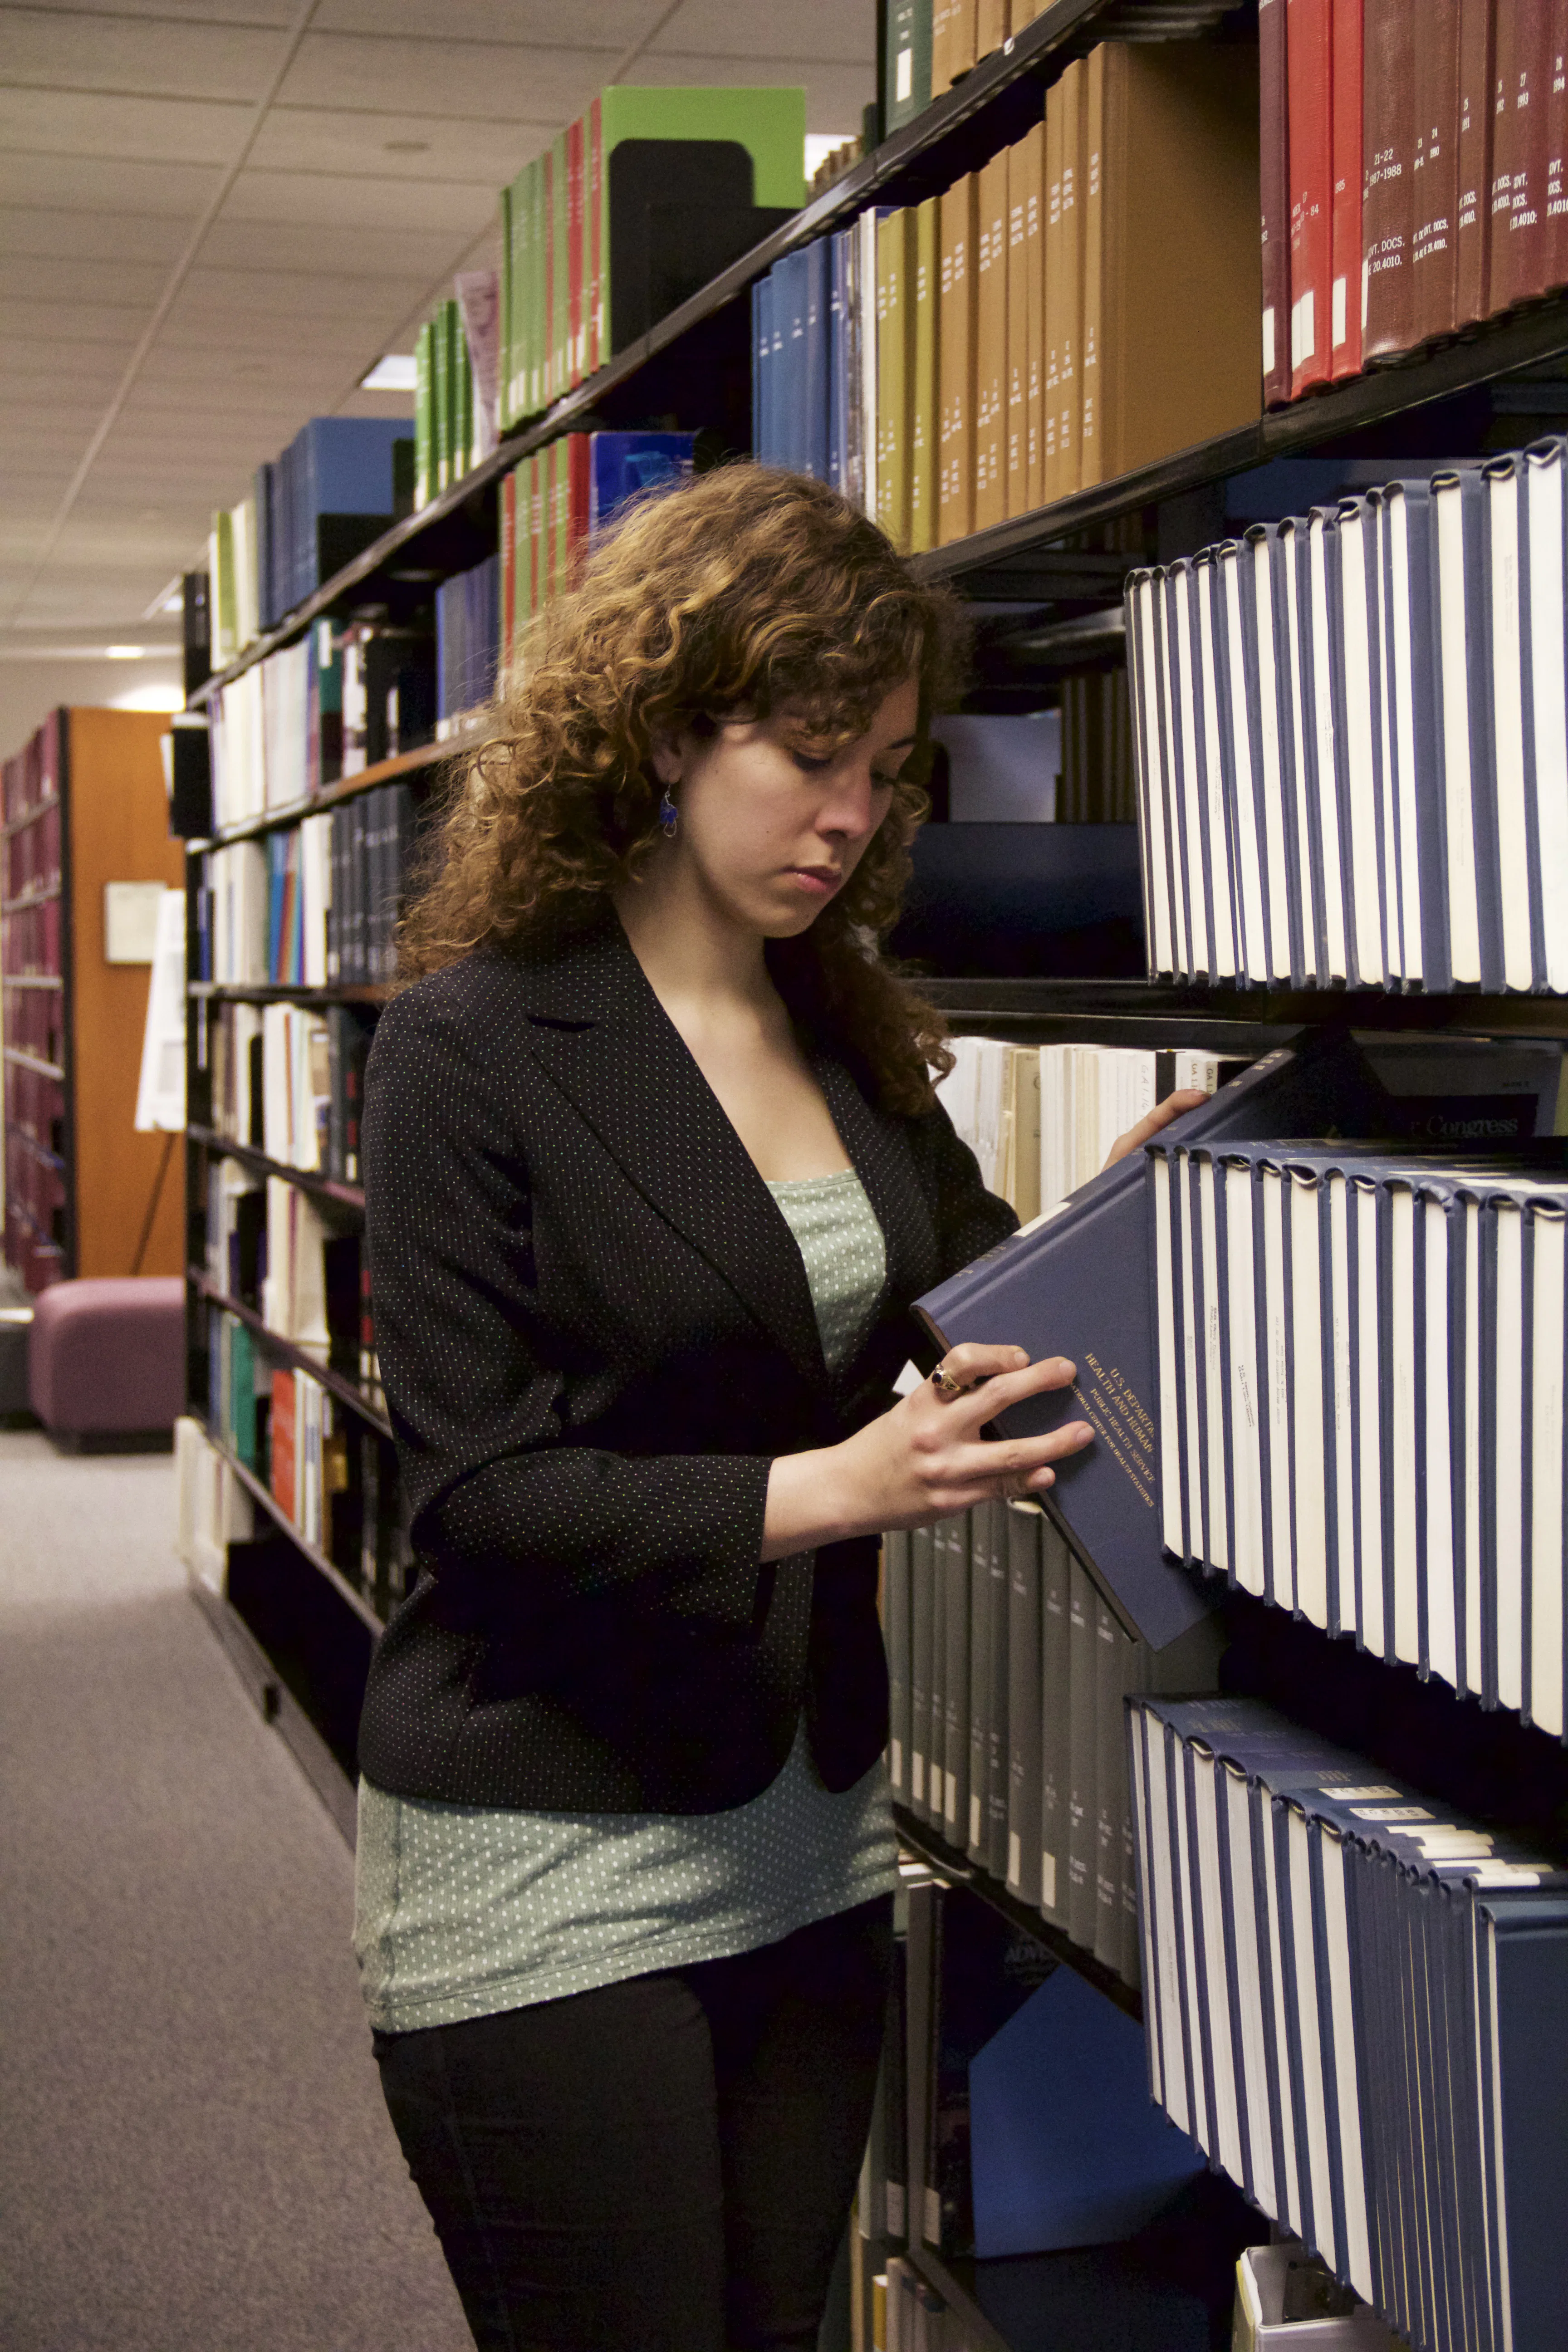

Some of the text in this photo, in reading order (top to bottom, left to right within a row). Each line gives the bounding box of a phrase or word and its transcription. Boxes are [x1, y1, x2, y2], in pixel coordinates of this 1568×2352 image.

[1374, 148, 1393, 166] 21-22
[1369, 163, 1402, 187] 1987-1988
[1381, 236, 1405, 252] DOCS.
[1372, 255, 1402, 273] 20.4010.
[1426, 1115, 1519, 1138] Congress
[1110, 1368, 1125, 1389] U.S.
[1084, 1352, 1154, 1453] HEALTH AND HUMAN
[1090, 1388, 1156, 1484] PUBLIC HEALTH SERVICE
[1088, 1411, 1107, 1436] CENTER
[1104, 1435, 1116, 1450] FOR
[1113, 1448, 1132, 1474] HEALTH
[1130, 1473, 1155, 1508] STATISTICS
